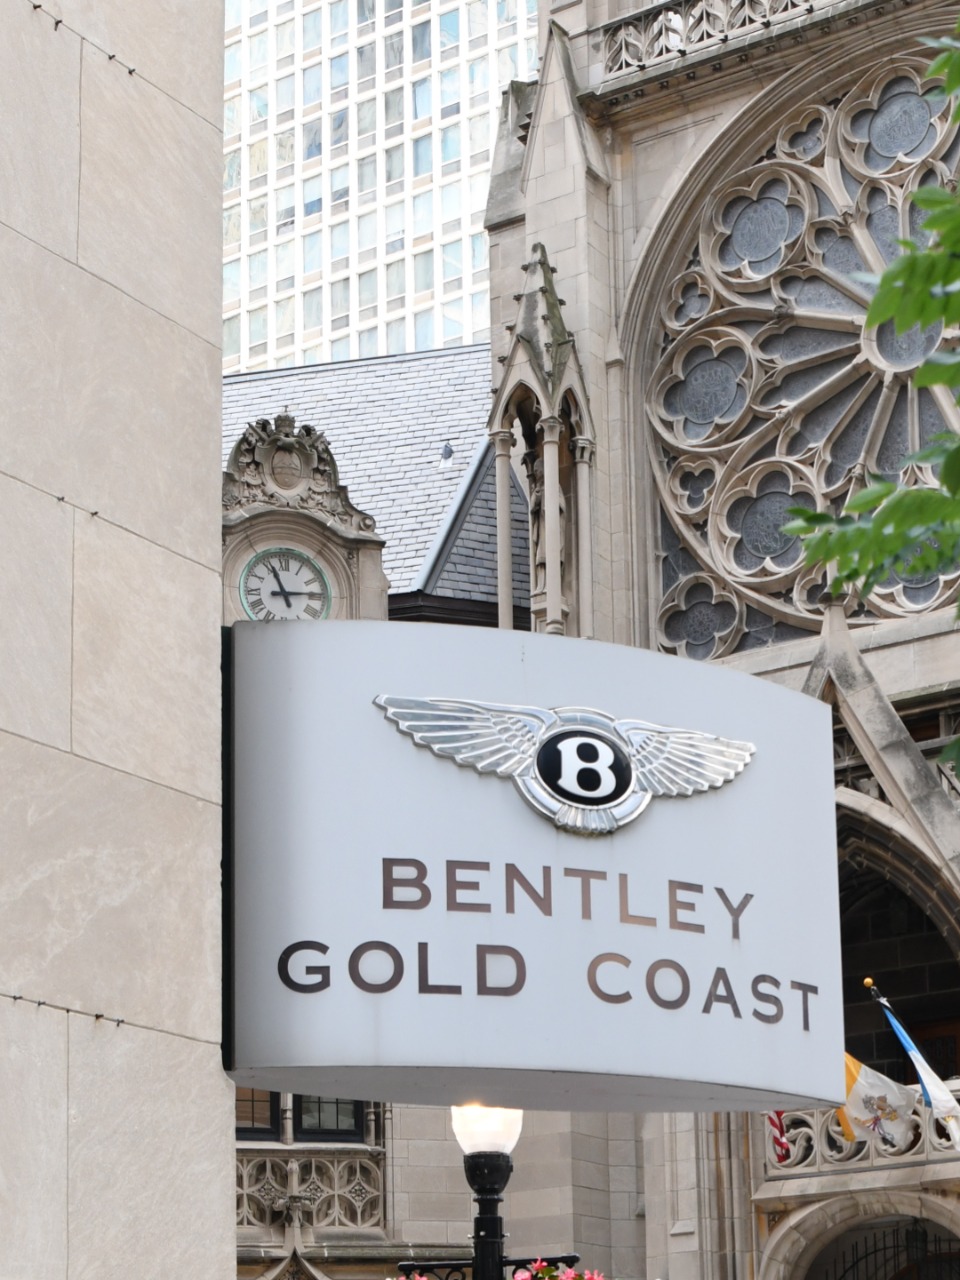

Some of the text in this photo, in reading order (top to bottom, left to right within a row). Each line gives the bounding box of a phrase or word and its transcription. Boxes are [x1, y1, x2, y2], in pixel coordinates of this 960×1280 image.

[556, 736, 617, 799] B
[381, 857, 755, 940] BENTLEY
[277, 940, 819, 1032] GOLD COAST
